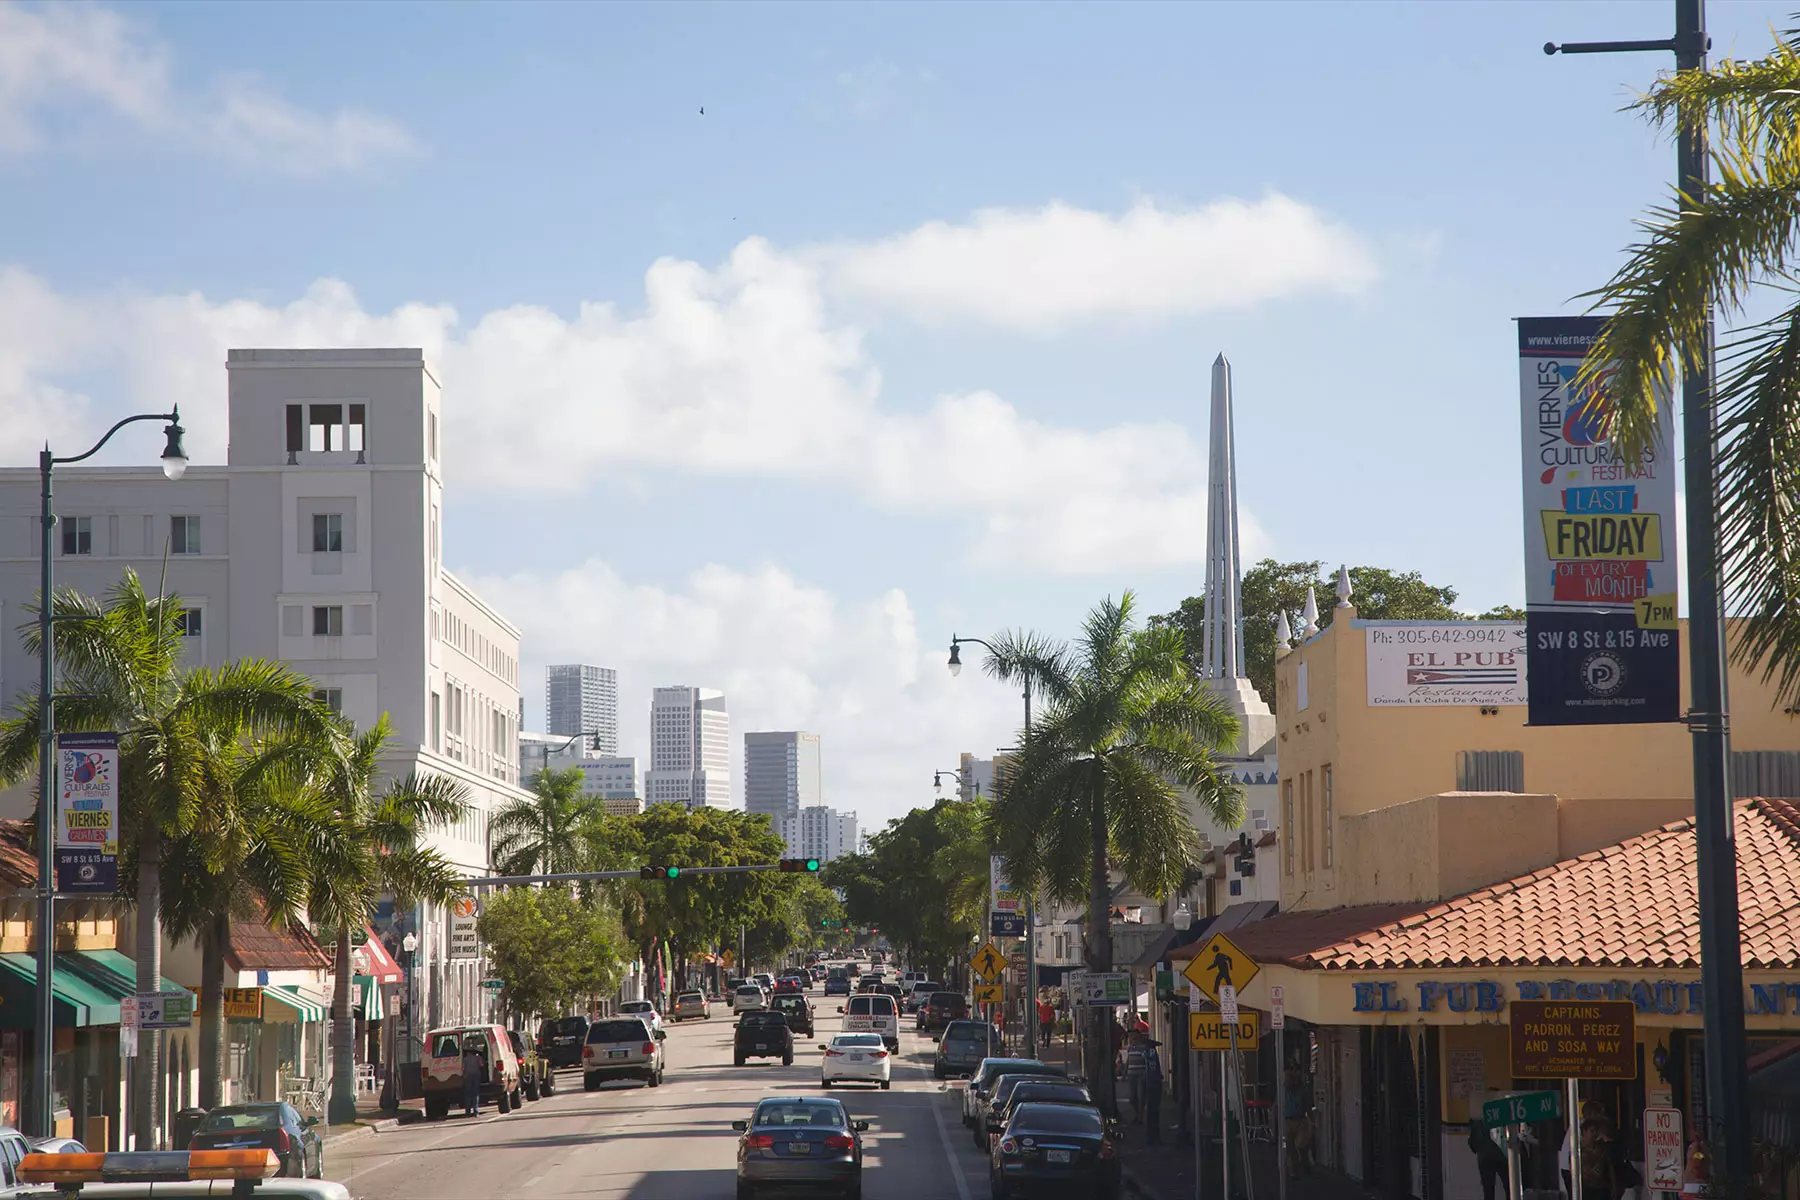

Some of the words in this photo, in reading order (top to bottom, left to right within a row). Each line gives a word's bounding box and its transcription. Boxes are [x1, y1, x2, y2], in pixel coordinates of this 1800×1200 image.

[1538, 360, 1561, 447] VIERNES
[1592, 465, 1656, 480] FESTIVAL
[1576, 489, 1628, 511] LAST
[1556, 517, 1650, 557] FRIDAY
[1559, 564, 1578, 576] OF
[1580, 562, 1630, 575] EVERY
[1585, 574, 1646, 598] MONTH
[1373, 630, 1393, 644] Ph:
[1397, 629, 1507, 644] 305-642-9942
[1538, 631, 1563, 649] SW
[1568, 630, 1578, 649] 8
[1583, 630, 1600, 648] St
[1640, 629, 1669, 648] Ave
[1407, 652, 1446, 667] EL
[1454, 651, 1516, 667] PUB
[1408, 685, 1516, 697] Restaurant
[1453, 696, 1467, 704] De
[1501, 695, 1518, 704] Se
[67, 812, 109, 827] VIERNES
[61, 855, 72, 864] SW
[455, 923, 473, 931] LOUNGE
[463, 934, 475, 942] ARTS
[1352, 981, 1405, 1012] EL
[1417, 980, 1505, 1012] PUB
[1544, 1007, 1600, 1019] CAPTAINS
[1196, 1023, 1254, 1040] AHEAD
[1583, 1024, 1620, 1036] PEREZ
[1525, 1041, 1549, 1053] AND
[1558, 1041, 1588, 1053] SOSA
[1597, 1041, 1621, 1053] WAY
[1486, 1108, 1500, 1121] SW
[1508, 1100, 1526, 1121] 16
[1540, 1098, 1552, 1113] AV
[1656, 1113, 1671, 1128] NO
[1647, 1131, 1680, 1146] PARKING
[1656, 1148, 1673, 1158] ANY
